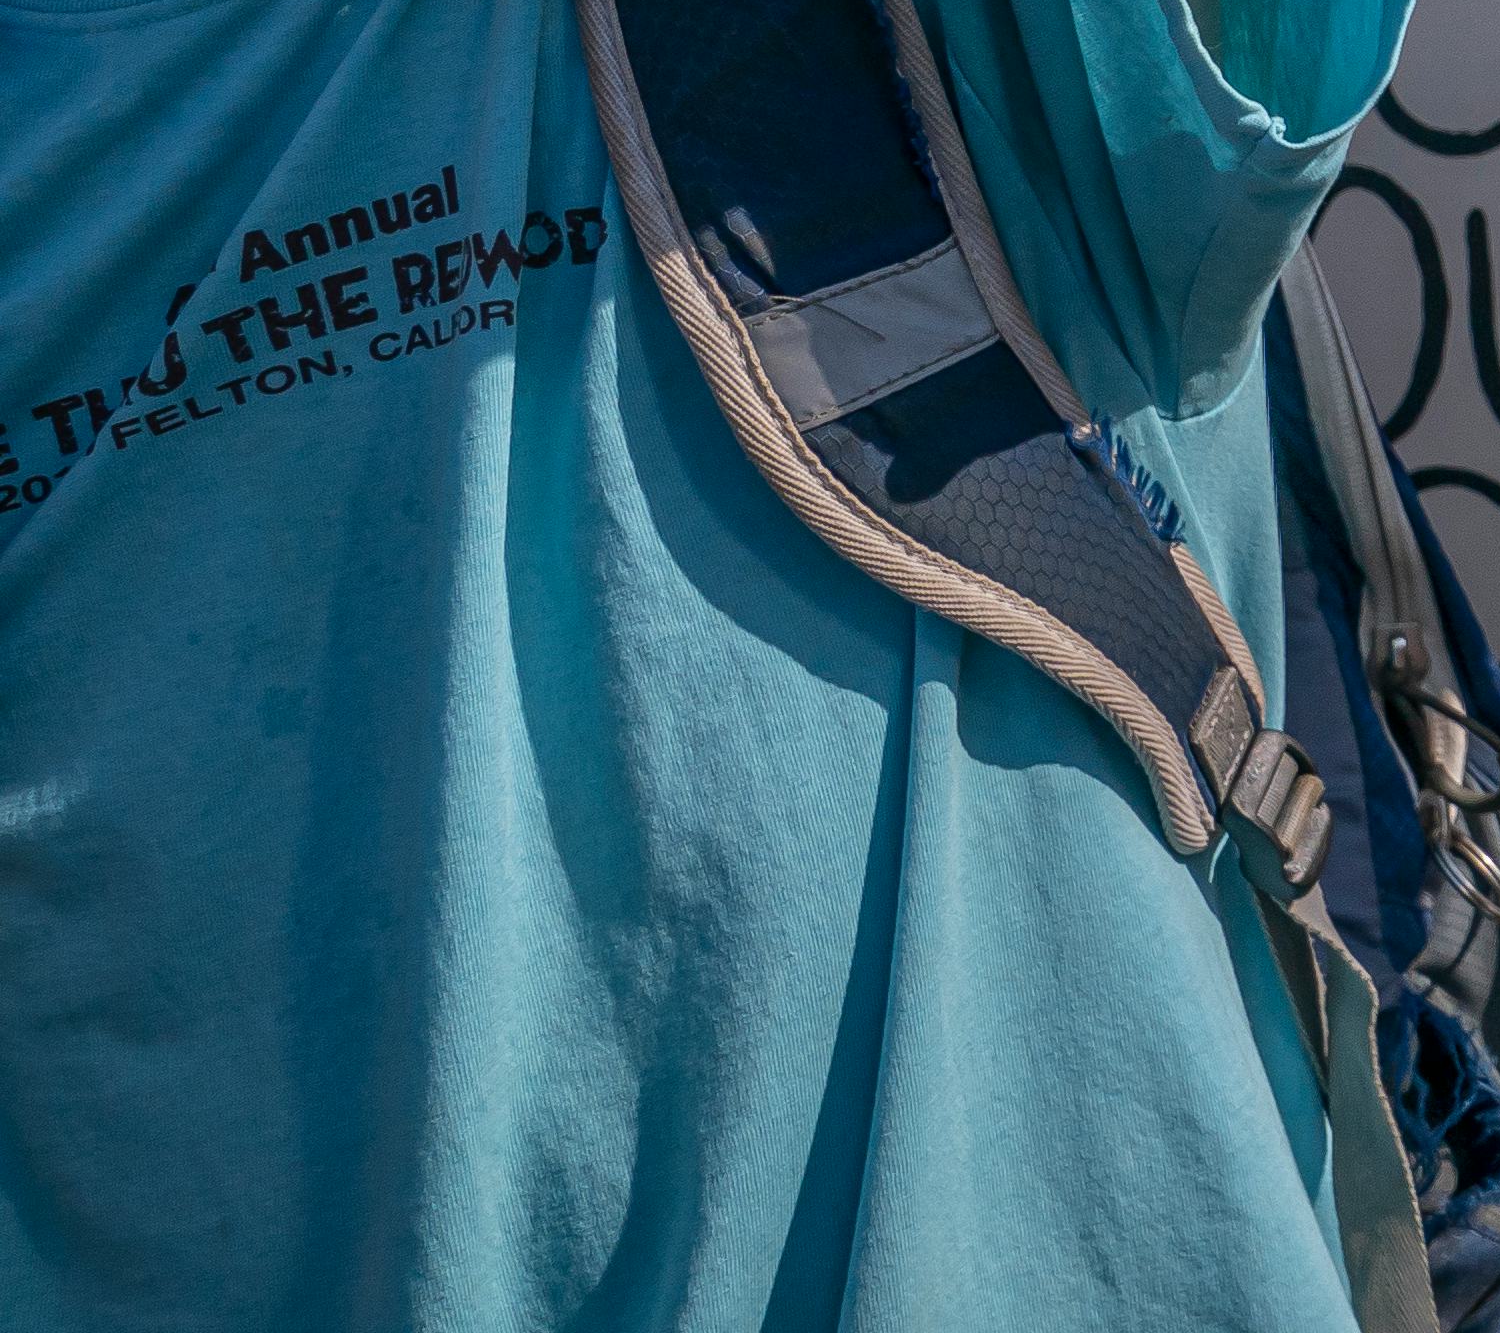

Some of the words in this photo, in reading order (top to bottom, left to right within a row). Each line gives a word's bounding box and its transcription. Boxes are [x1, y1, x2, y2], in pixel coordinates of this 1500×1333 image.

[240, 165, 460, 283] Annual
[200, 266, 378, 363] THE
[109, 349, 353, 450] FELTON,
